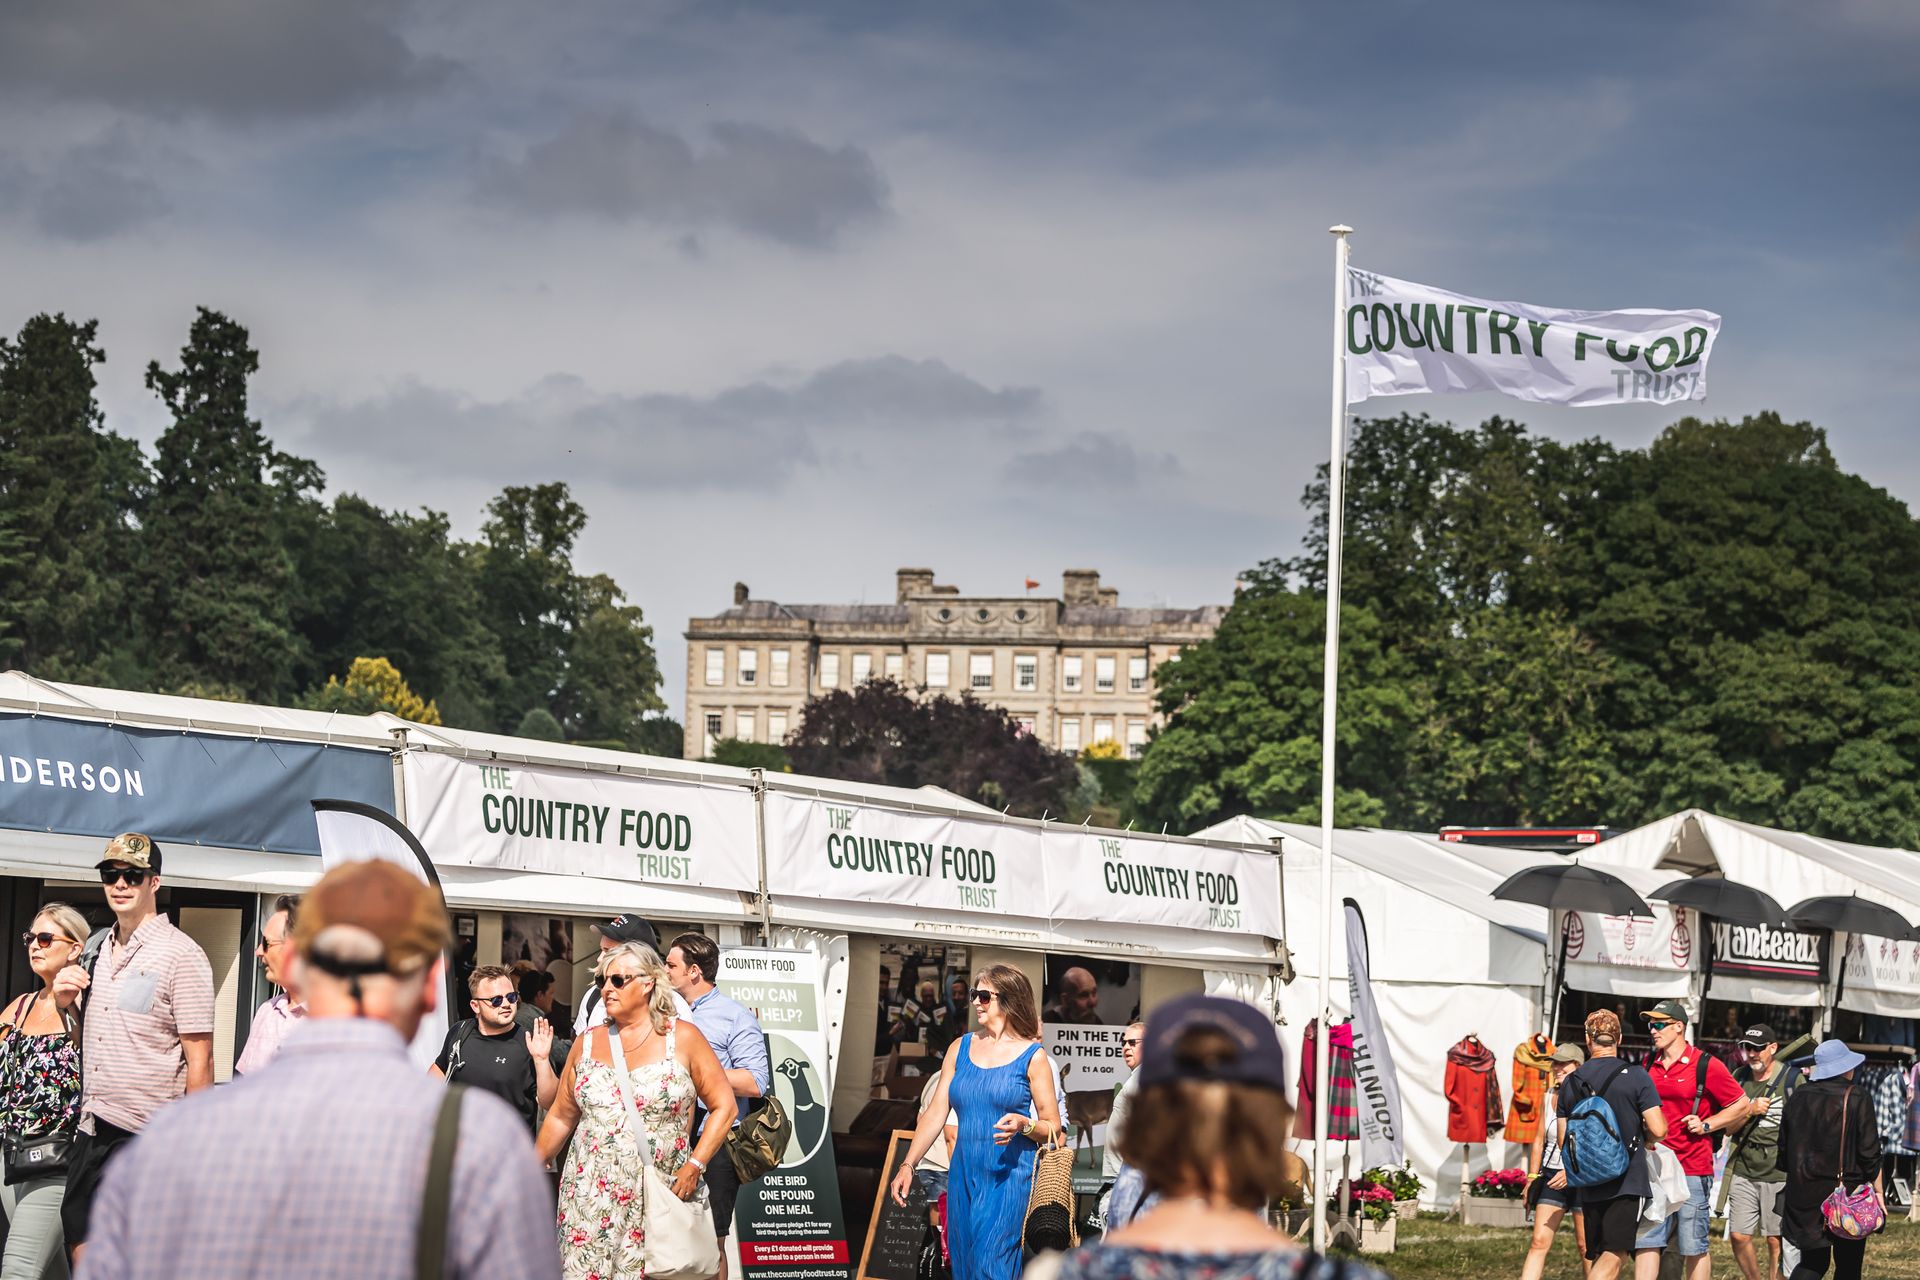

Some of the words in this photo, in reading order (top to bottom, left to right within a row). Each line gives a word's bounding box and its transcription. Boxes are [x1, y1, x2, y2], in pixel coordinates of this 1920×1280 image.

[1347, 303, 1550, 358] COUNTRY
[1610, 369, 1700, 401] TRUST
[0, 754, 145, 796] DERSON
[479, 765, 512, 790] THE
[482, 793, 611, 845] COUNTRY
[619, 809, 692, 852] FOOD
[826, 807, 853, 831] THE
[827, 833, 934, 877] COUNTRY
[941, 845, 996, 884] FOOD
[1098, 838, 1123, 859] THE
[636, 853, 692, 880] TRUST
[1103, 861, 1190, 900] COUNTRY
[1196, 871, 1239, 905] FOOD
[957, 885, 998, 909] TRUST
[1208, 907, 1241, 929] TRUST
[1711, 922, 1821, 963] Manteaux
[725, 957, 768, 970] COUNTRY
[771, 960, 796, 971] FOOD
[731, 987, 764, 1001] HOW
[768, 988, 798, 1002] CAN
[762, 1007, 803, 1022] HELP?
[1057, 1030, 1079, 1041] PIN
[1083, 1031, 1109, 1042] THE
[1112, 1032, 1125, 1043] TA
[1053, 1045, 1072, 1057] ON
[1076, 1046, 1101, 1057] THE
[1105, 1047, 1122, 1058] DE
[1100, 1066, 1114, 1074] GO!
[1361, 1115, 1382, 1144] THE
[763, 1176, 784, 1186] ONE
[785, 1175, 807, 1186] BIRD
[759, 1190, 780, 1200] ONE
[781, 1190, 815, 1200] POUND
[765, 1205, 785, 1215] ONE
[786, 1205, 813, 1215] MEAL
[754, 1245, 770, 1253] Every
[813, 1244, 833, 1252] provide
[749, 1269, 848, 1279] www.thecountryfoodtrust.org
